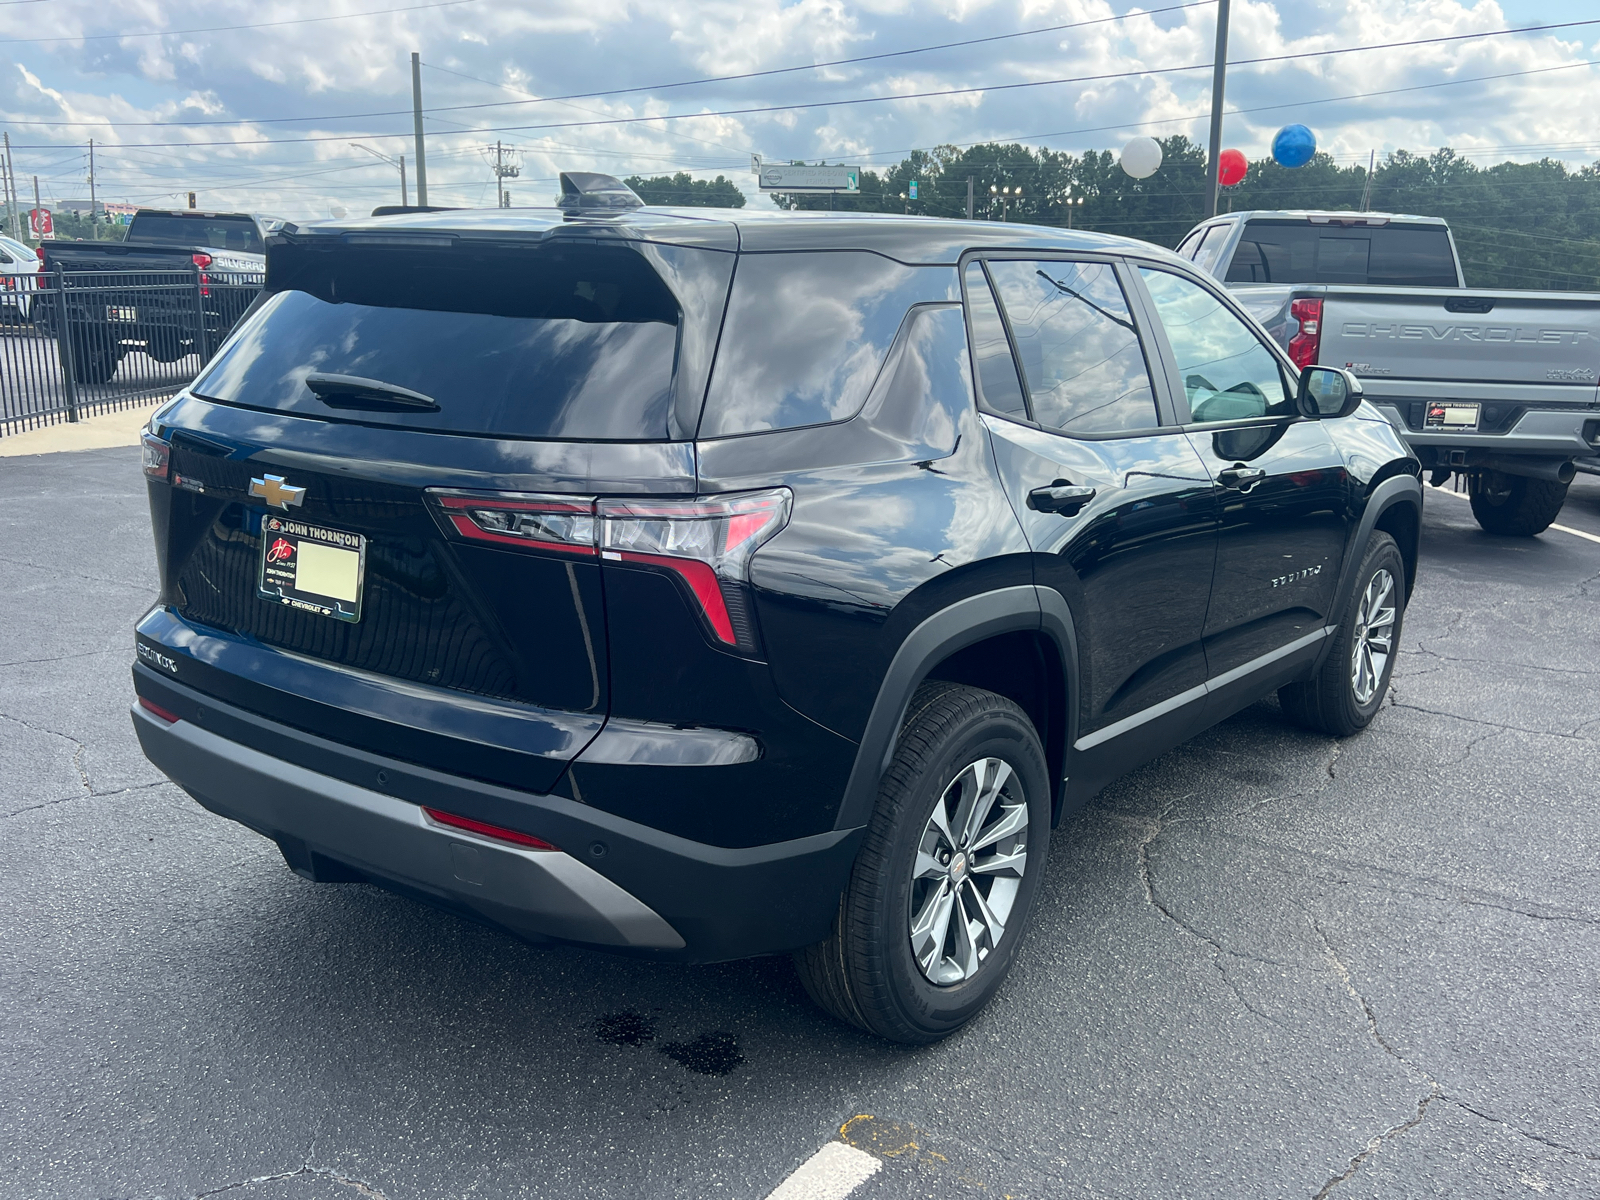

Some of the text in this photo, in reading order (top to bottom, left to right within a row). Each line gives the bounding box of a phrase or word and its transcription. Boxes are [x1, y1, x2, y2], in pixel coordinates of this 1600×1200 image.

[217, 257, 266, 271] SILVERAD
[1341, 322, 1589, 345] CHEVROLET
[284, 521, 308, 537] JOHN
[309, 526, 359, 548] THORNTON
[291, 600, 322, 614] CHEVROLET
[137, 642, 178, 673] EQUINOX
